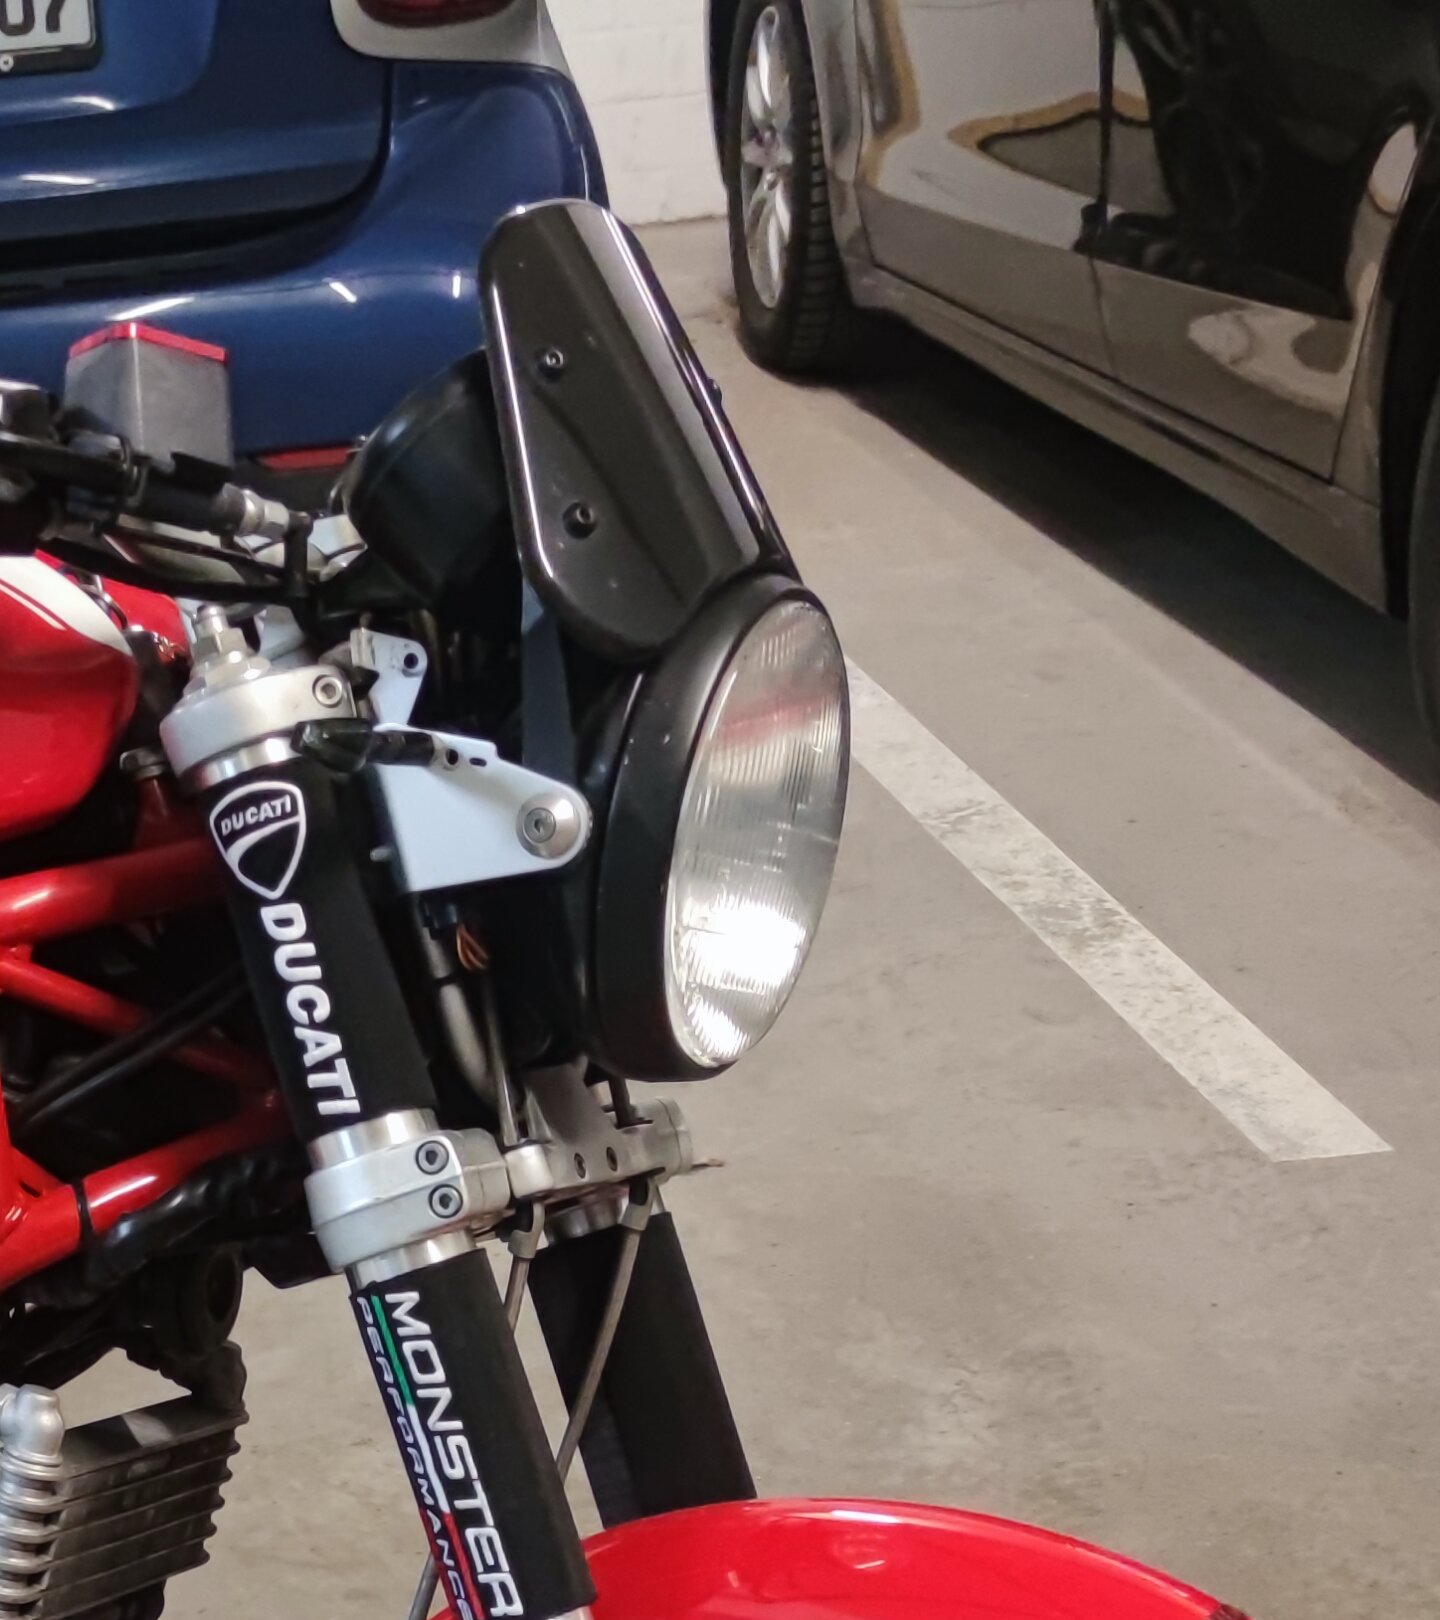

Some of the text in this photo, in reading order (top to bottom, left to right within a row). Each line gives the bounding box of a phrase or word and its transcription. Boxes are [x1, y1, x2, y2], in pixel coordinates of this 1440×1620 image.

[221, 794, 292, 836] DUCATI
[260, 902, 361, 1116] DUCATI
[384, 1290, 524, 1617] MONSTER
